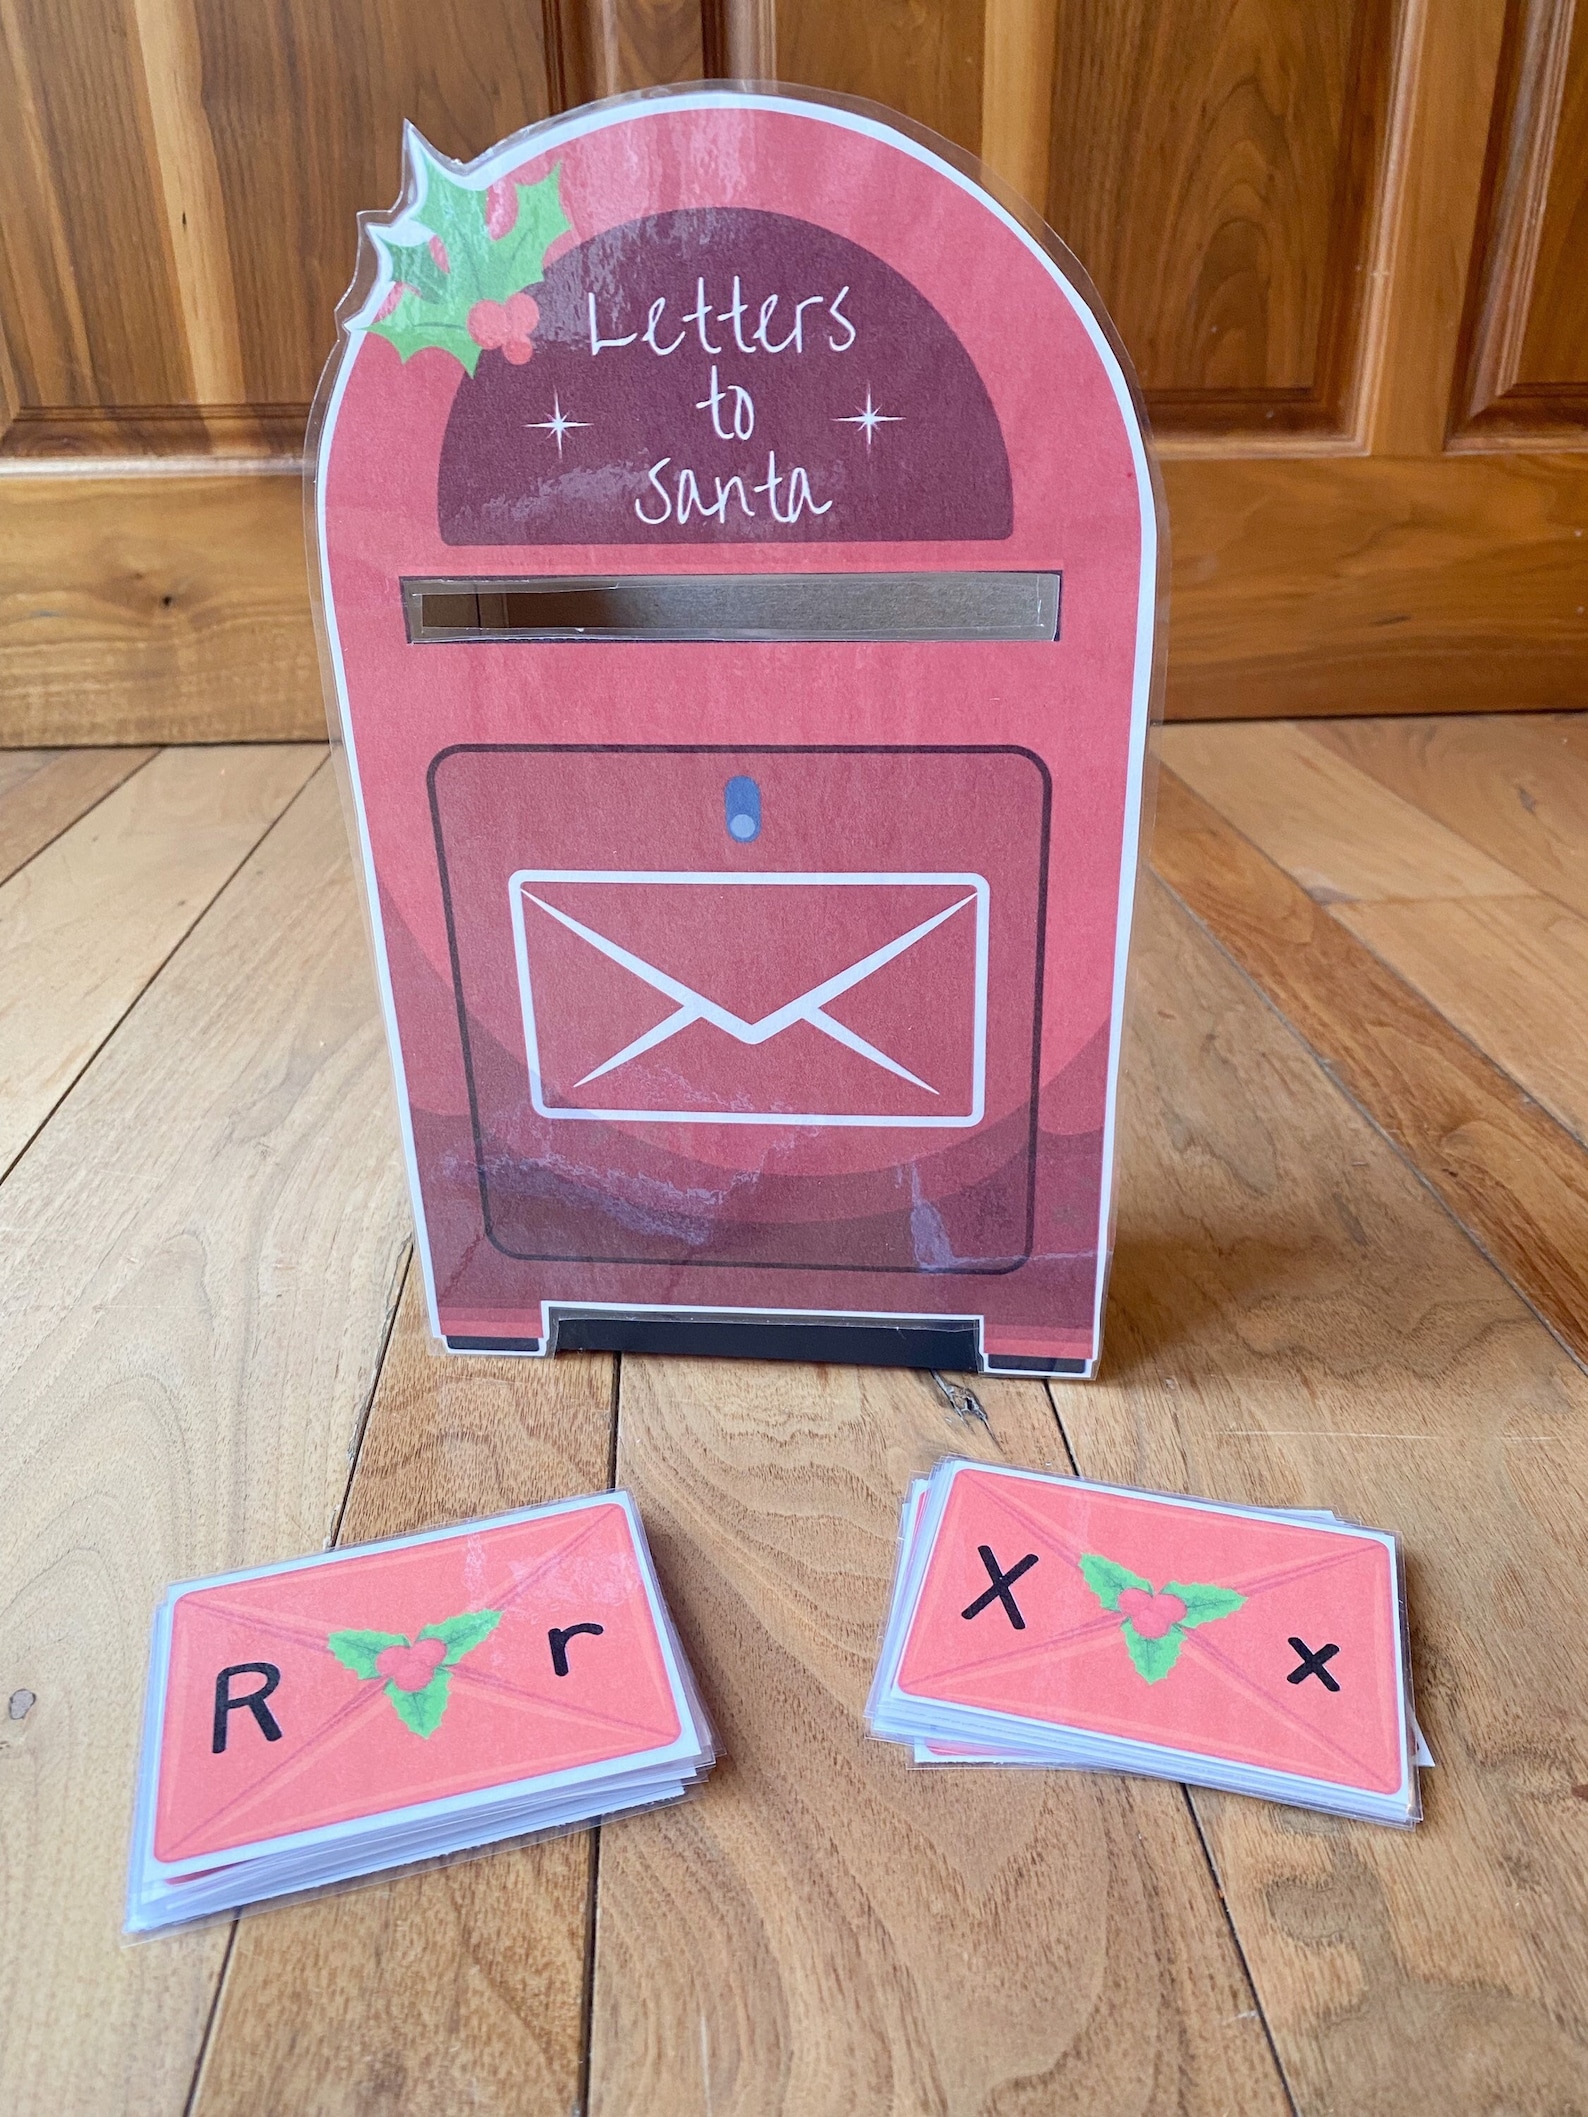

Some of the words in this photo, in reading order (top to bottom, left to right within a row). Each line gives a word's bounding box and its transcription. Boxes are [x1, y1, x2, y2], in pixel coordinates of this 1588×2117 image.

[587, 275, 857, 356] Letters
[695, 364, 755, 441] to
[960, 1544, 1040, 1631] X
[1285, 1636, 1341, 1693] x
[210, 1661, 283, 1755] R
[547, 1621, 605, 1678] r
